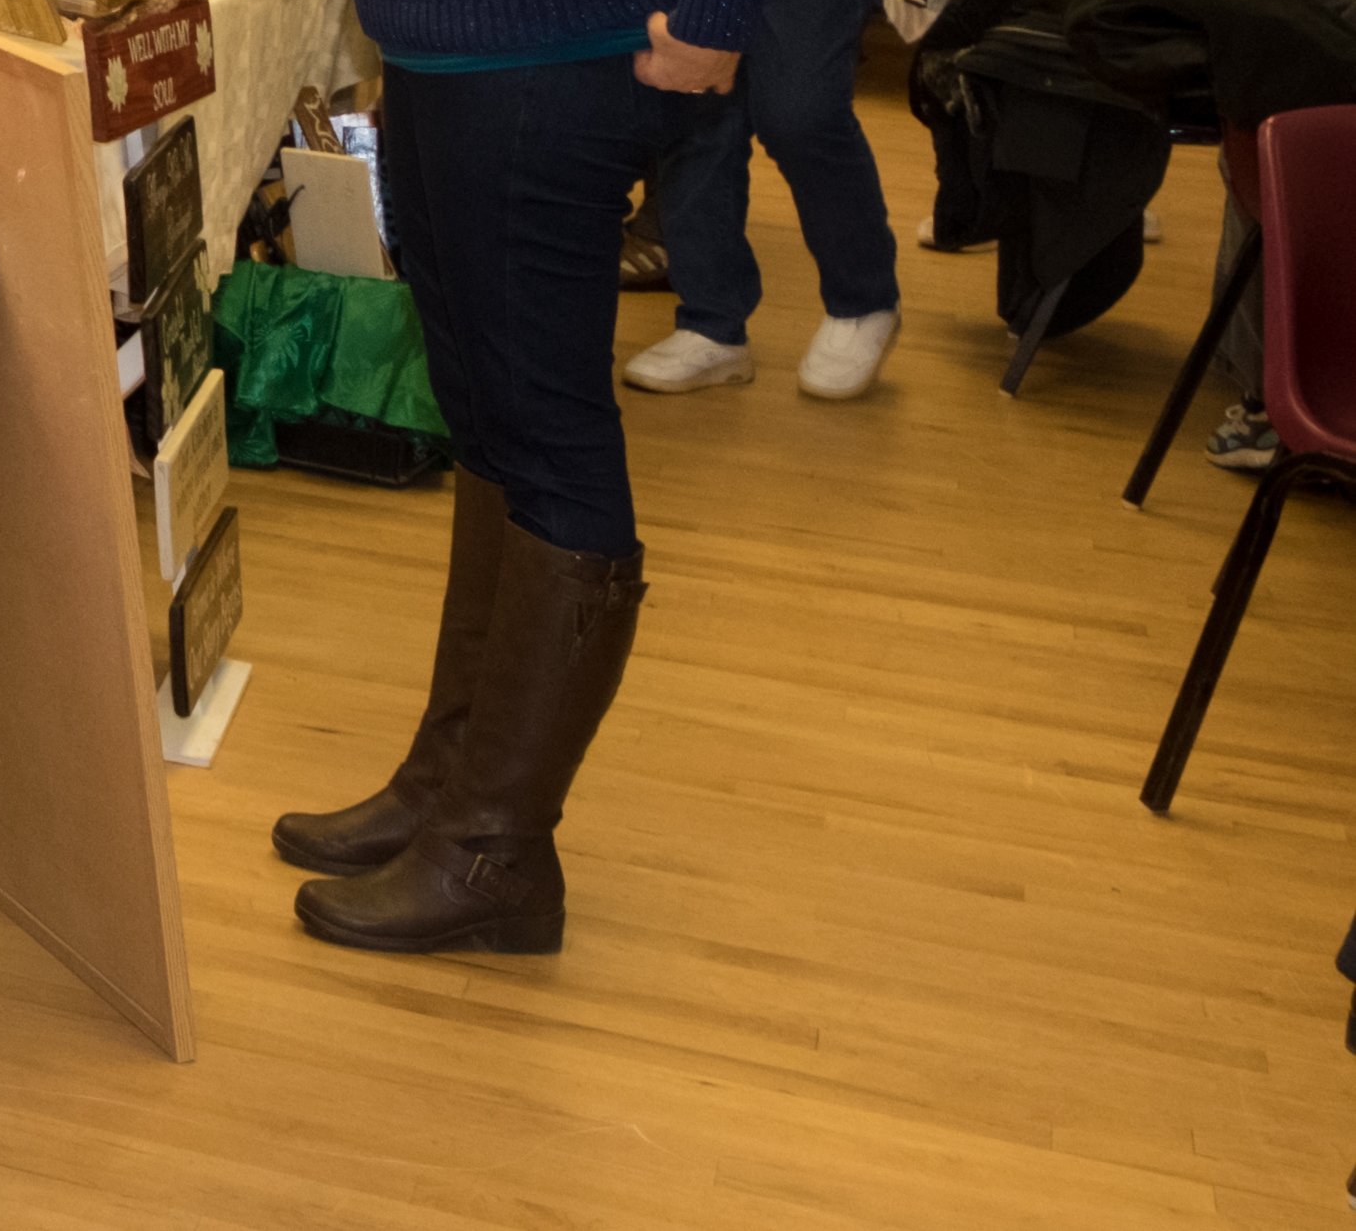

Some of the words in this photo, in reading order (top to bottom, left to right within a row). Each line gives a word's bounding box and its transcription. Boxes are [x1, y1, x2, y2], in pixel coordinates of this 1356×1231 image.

[127, 31, 153, 64] WELL
[152, 22, 176, 55] WITH
[175, 19, 190, 50] MY
[153, 77, 177, 111] SOUL
